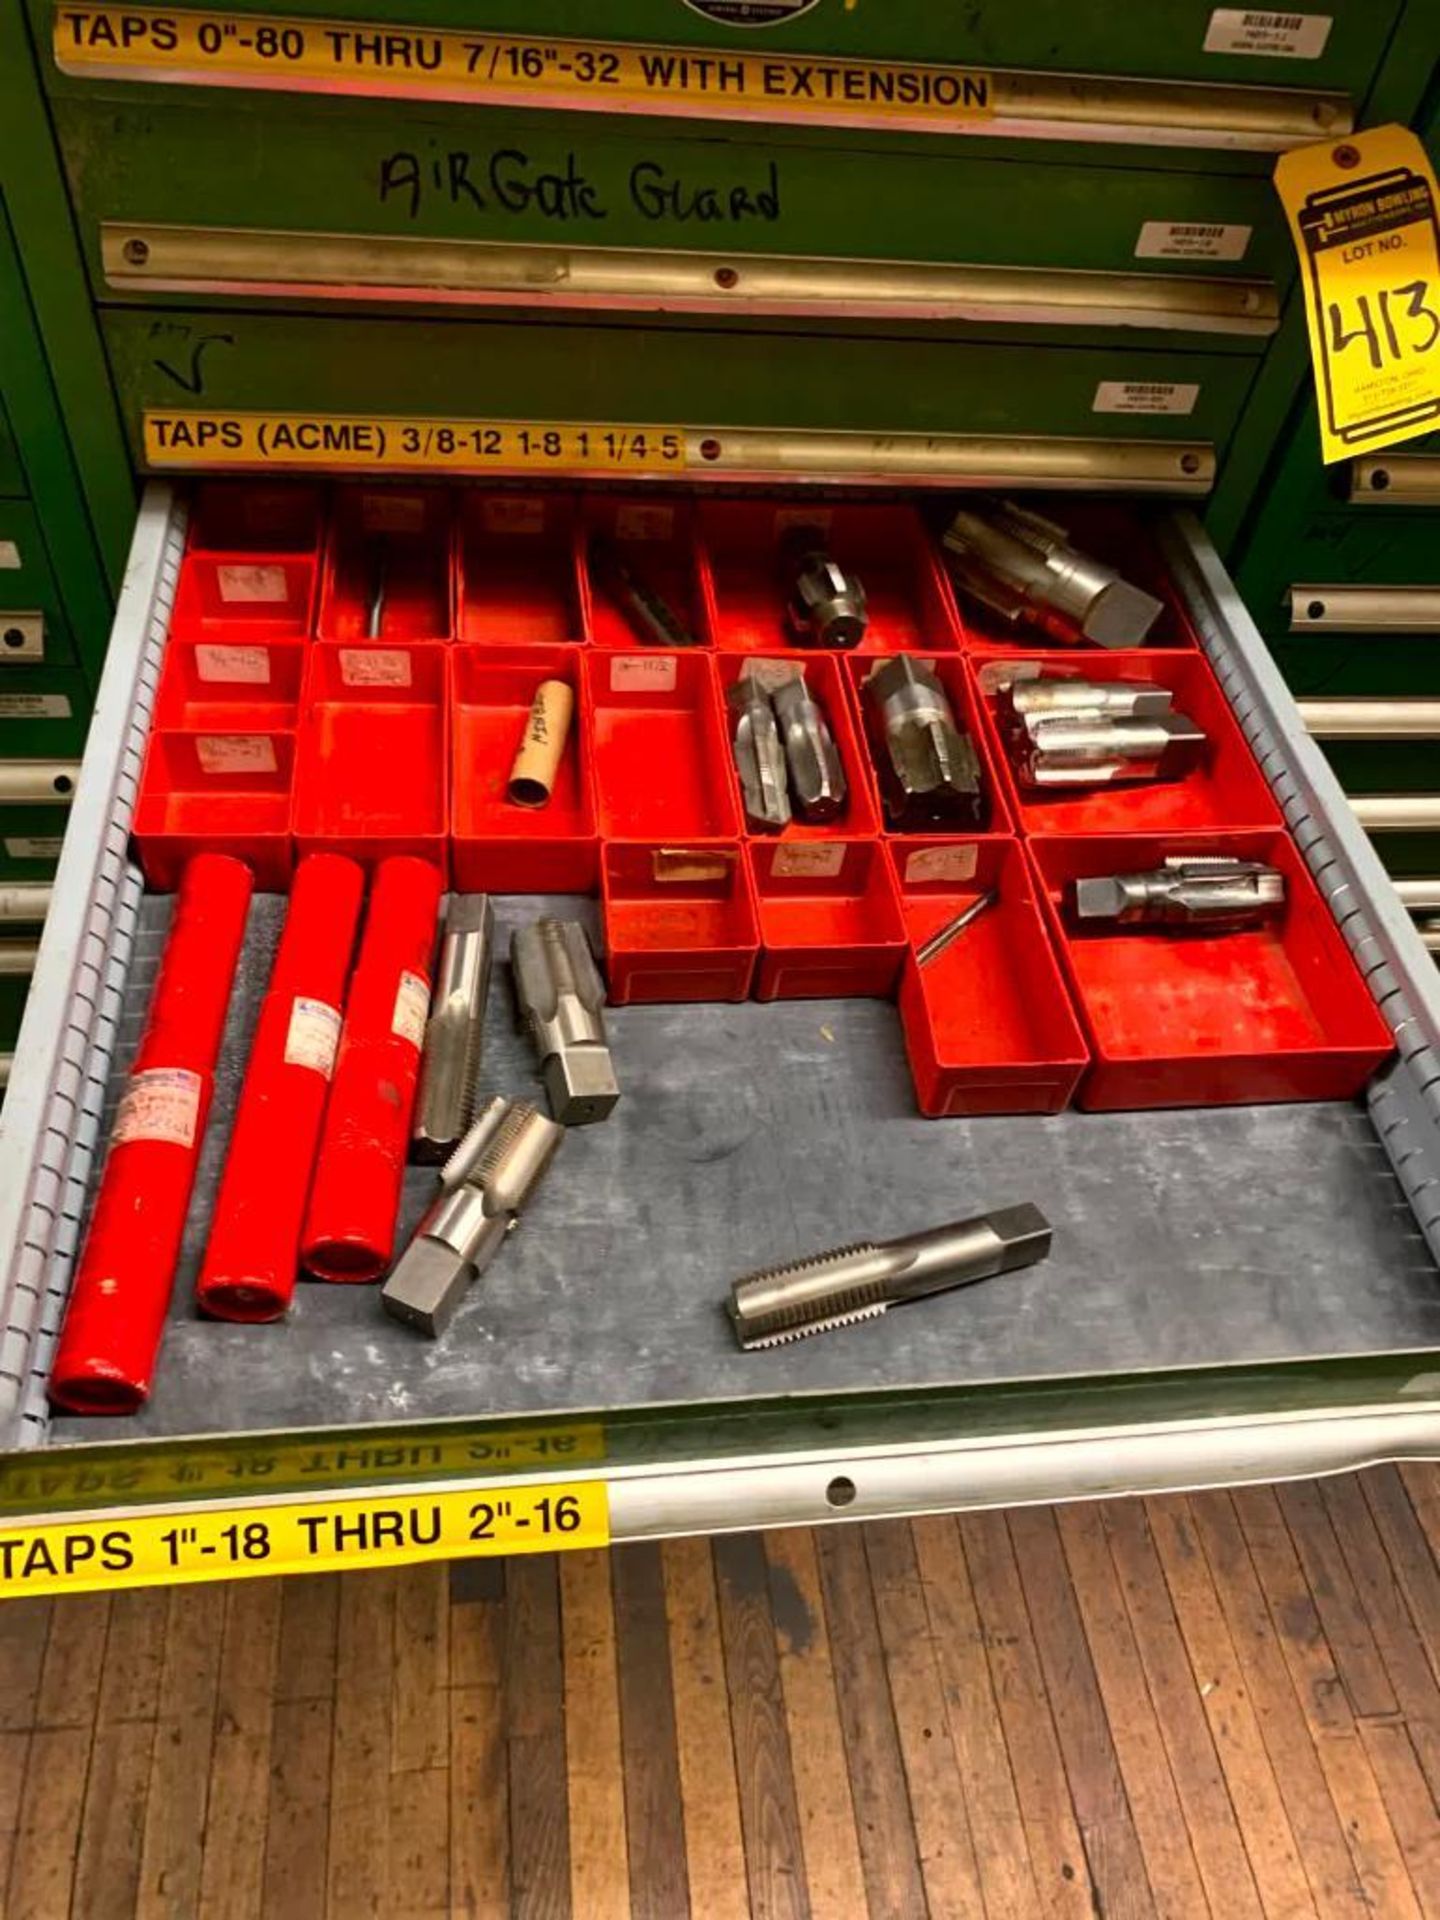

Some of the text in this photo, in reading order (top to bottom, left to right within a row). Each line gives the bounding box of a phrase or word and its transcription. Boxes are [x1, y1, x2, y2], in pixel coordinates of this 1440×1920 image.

[64, 13, 988, 107] TAPS 0"-80 THRU 7/16"-32 WITH EXTENSION
[1342, 235, 1408, 264] LOT NO.
[1329, 280, 1440, 368] 413
[151, 420, 679, 461] TAPS (ACME) 3/8-12 1-8 1 1/4-5
[0, 1496, 580, 1578] TAPS 1"-18 THRU 2"-16
